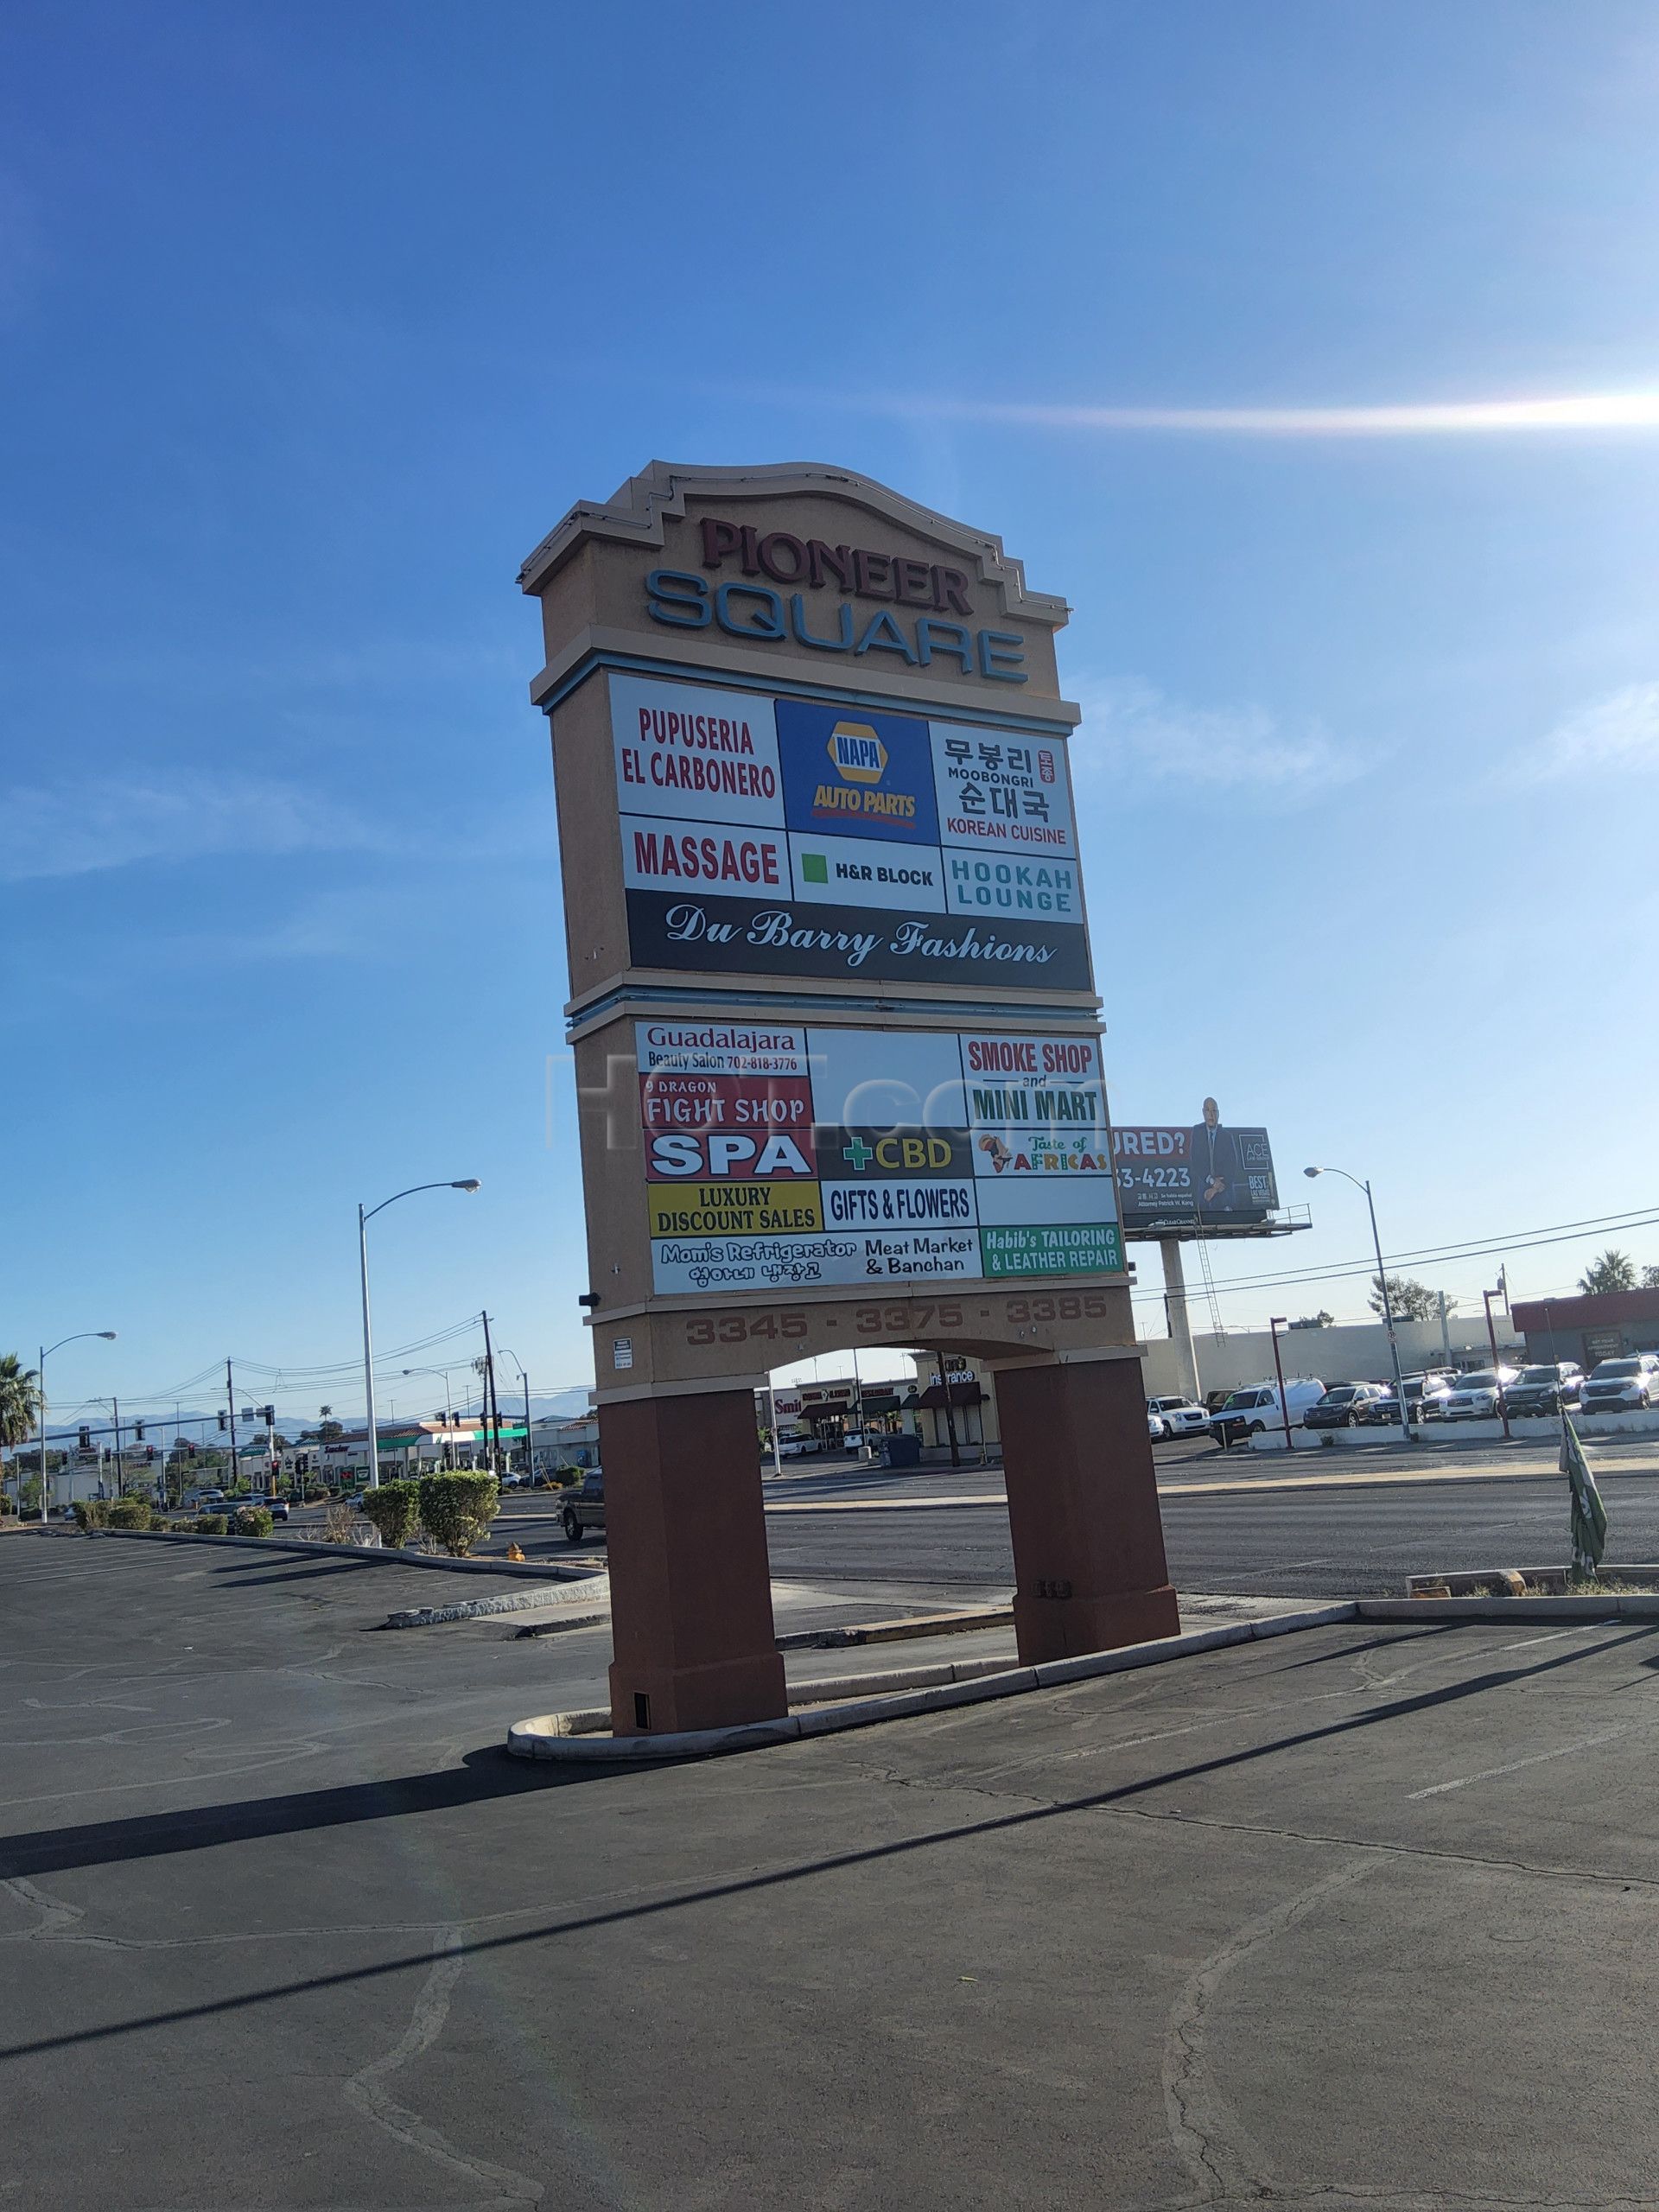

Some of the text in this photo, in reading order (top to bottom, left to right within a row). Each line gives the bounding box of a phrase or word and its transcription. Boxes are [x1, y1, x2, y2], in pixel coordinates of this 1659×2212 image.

[700, 518, 974, 615] PIONEER
[645, 569, 1028, 683] SQUARE
[639, 708, 754, 754] PUPUSERIA
[836, 736, 880, 769] NAPA
[944, 739, 1032, 773] 무봉리
[621, 748, 775, 798] EL CARBONERO
[948, 767, 1033, 788] MOOBONGRI
[813, 785, 915, 817] AUTO PARTS
[958, 782, 1049, 823] 순대국
[947, 817, 1066, 845] KOREAN CUISINE
[634, 831, 779, 885] MASSAGE
[836, 862, 933, 886] H&R BLOCK
[951, 859, 1071, 889] HOOKAH
[957, 885, 1071, 912] LOUNGE
[664, 903, 1058, 966] Du Barry Fashions
[647, 1027, 795, 1052] Guadalajara
[648, 1051, 797, 1071] Beauty Salon 702-818-3776
[968, 1040, 1092, 1073] SMOKE SHOP
[645, 1081, 716, 1093] 9 DRAGON
[1022, 1074, 1047, 1088] and
[647, 1097, 804, 1122] FIGHT SHOP
[973, 1089, 1096, 1121] MINI MART
[651, 1134, 813, 1176] SPA
[875, 1137, 952, 1170] CBD
[1028, 1136, 1087, 1153] Taste of
[1247, 1143, 1268, 1156] ACE
[1014, 1154, 1107, 1170] AFRICAS
[1249, 1176, 1267, 1189] BEST
[699, 1187, 771, 1206] LUXURY
[830, 1188, 969, 1221] GIFTS & FLOWERS
[658, 1209, 815, 1231] DISCOUNT SALES
[661, 1239, 856, 1263] Mom's Refrigerator
[865, 1237, 973, 1256] Meat Market
[987, 1229, 1116, 1250] Habib's TAILORING
[761, 1262, 822, 1282] 냉장고
[866, 1258, 964, 1274] & Banchan
[993, 1249, 1117, 1270] & LEATHER REPAIR
[686, 1313, 809, 1345] 3345
[856, 1303, 963, 1333] 3375
[1006, 1296, 1107, 1325] 3385
[930, 1370, 974, 1385] Insrance
